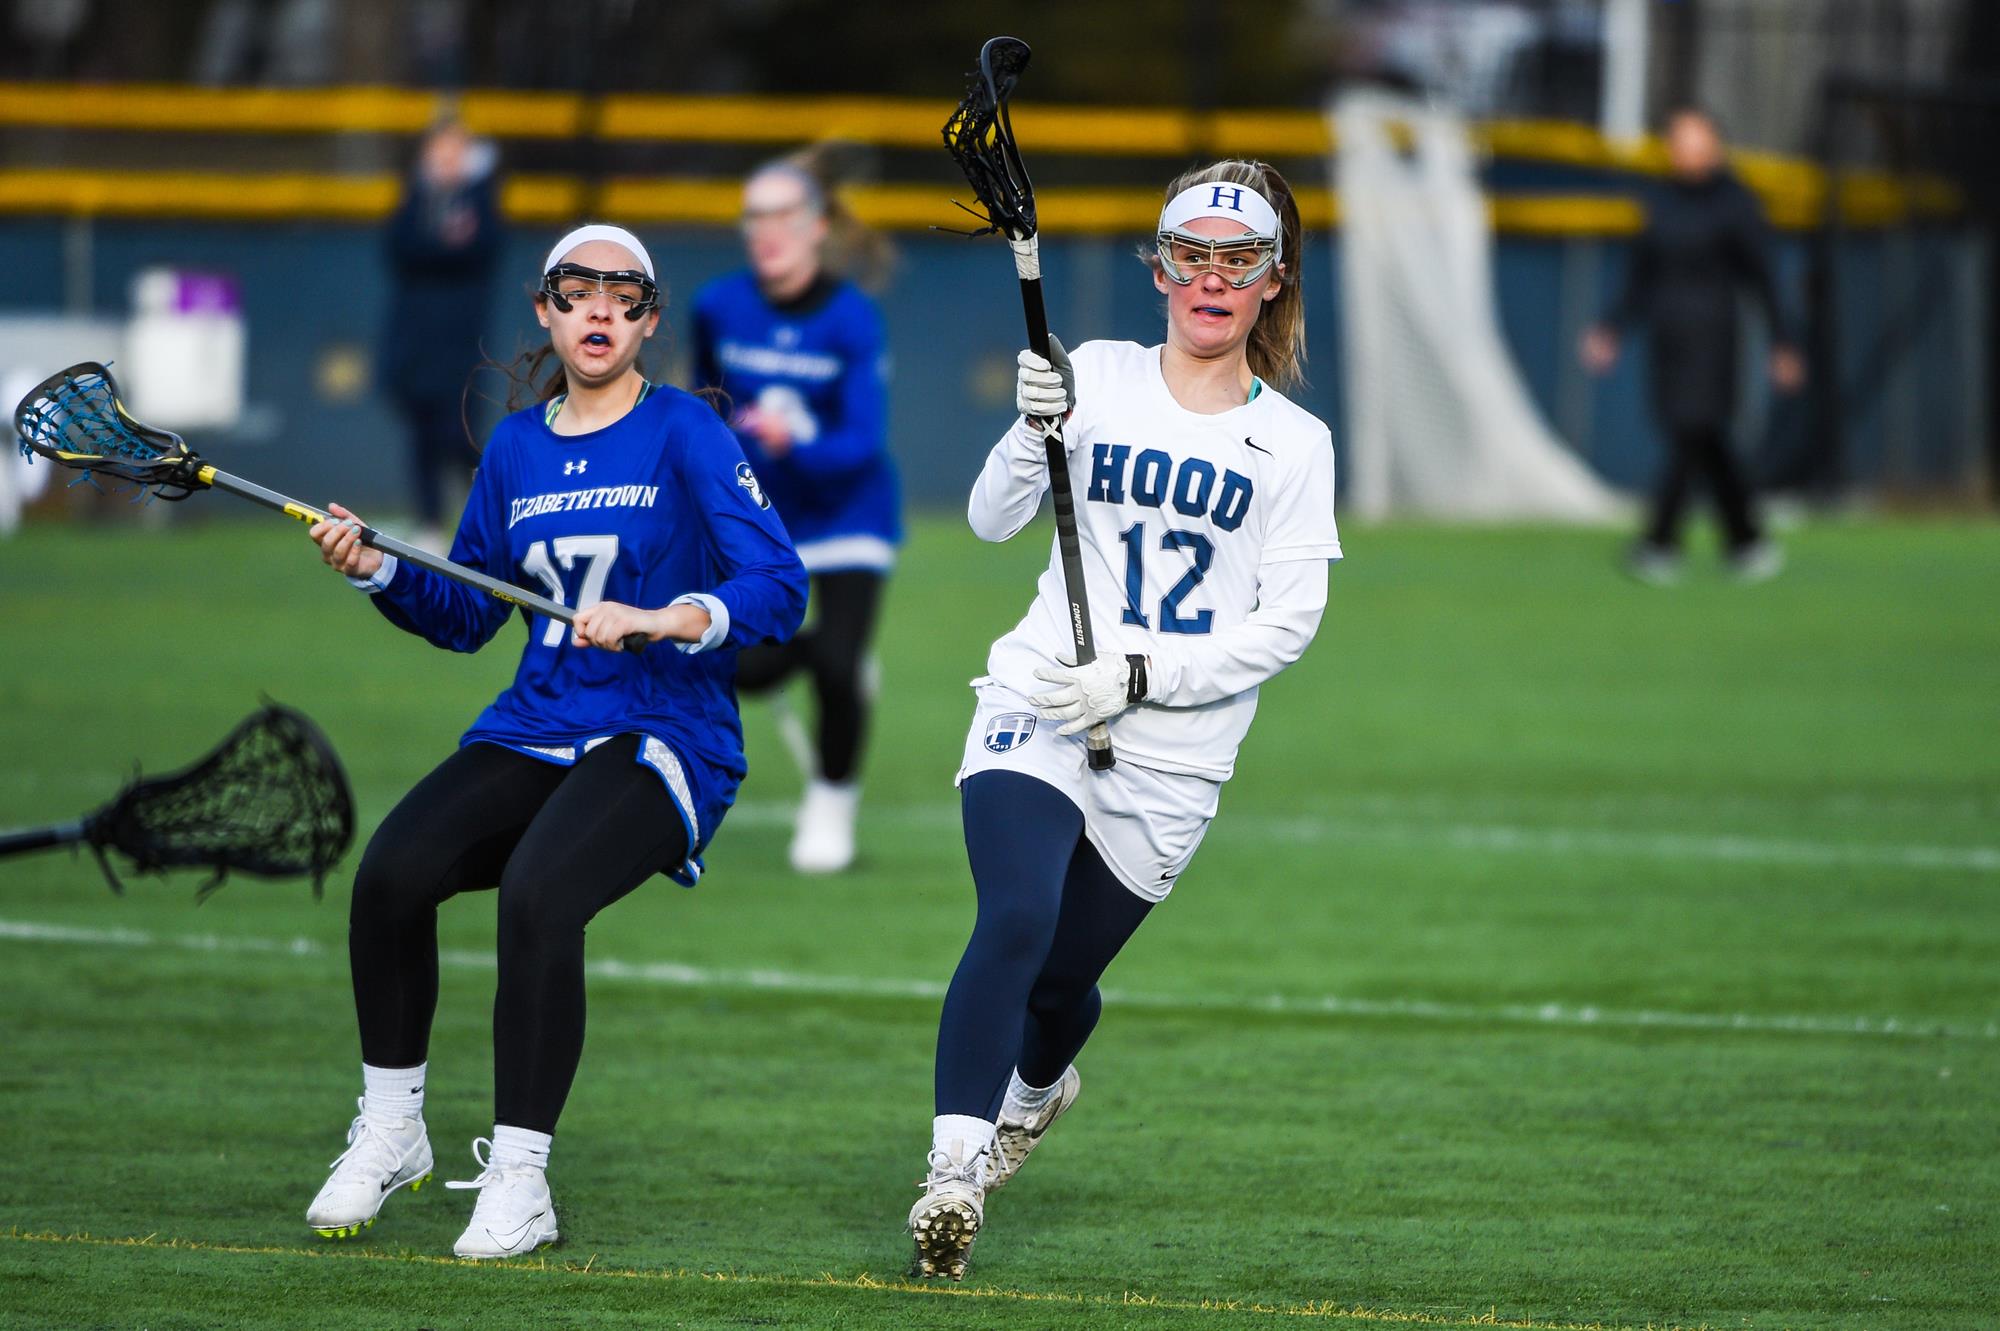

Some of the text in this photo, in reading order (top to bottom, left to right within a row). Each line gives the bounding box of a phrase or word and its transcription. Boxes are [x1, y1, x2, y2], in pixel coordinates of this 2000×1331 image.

[1207, 186, 1245, 212] H
[1087, 443, 1254, 532] HOOD
[521, 534, 619, 648] 17
[1118, 521, 1216, 636] 12
[1072, 601, 1085, 647] COMPOSITE
